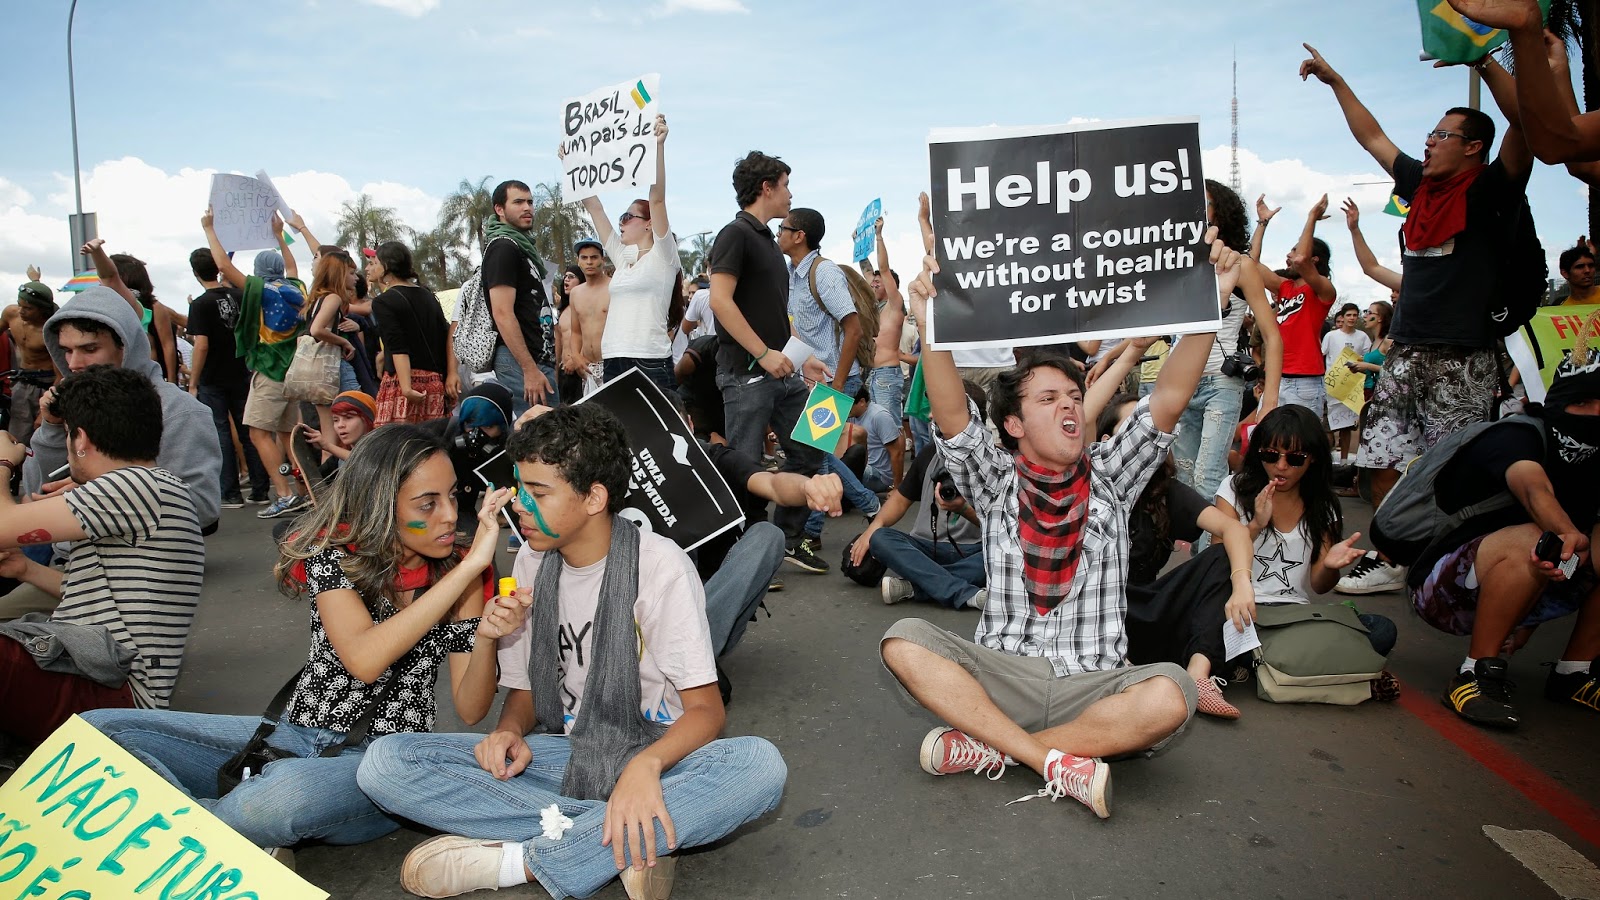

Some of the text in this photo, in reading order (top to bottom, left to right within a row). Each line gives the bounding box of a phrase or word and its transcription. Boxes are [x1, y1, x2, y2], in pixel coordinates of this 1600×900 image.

[563, 113, 651, 156] um país de
[567, 144, 646, 191] TODOS?
[947, 148, 1192, 214] Help us!
[943, 218, 1204, 261] We're a country
[955, 245, 1194, 290] without health
[1008, 279, 1146, 314] for twist
[628, 447, 647, 482] DE
[641, 478, 678, 528] MUDA
[639, 447, 667, 487] UMA
[20, 742, 139, 841] NÃO
[96, 806, 191, 876] É
